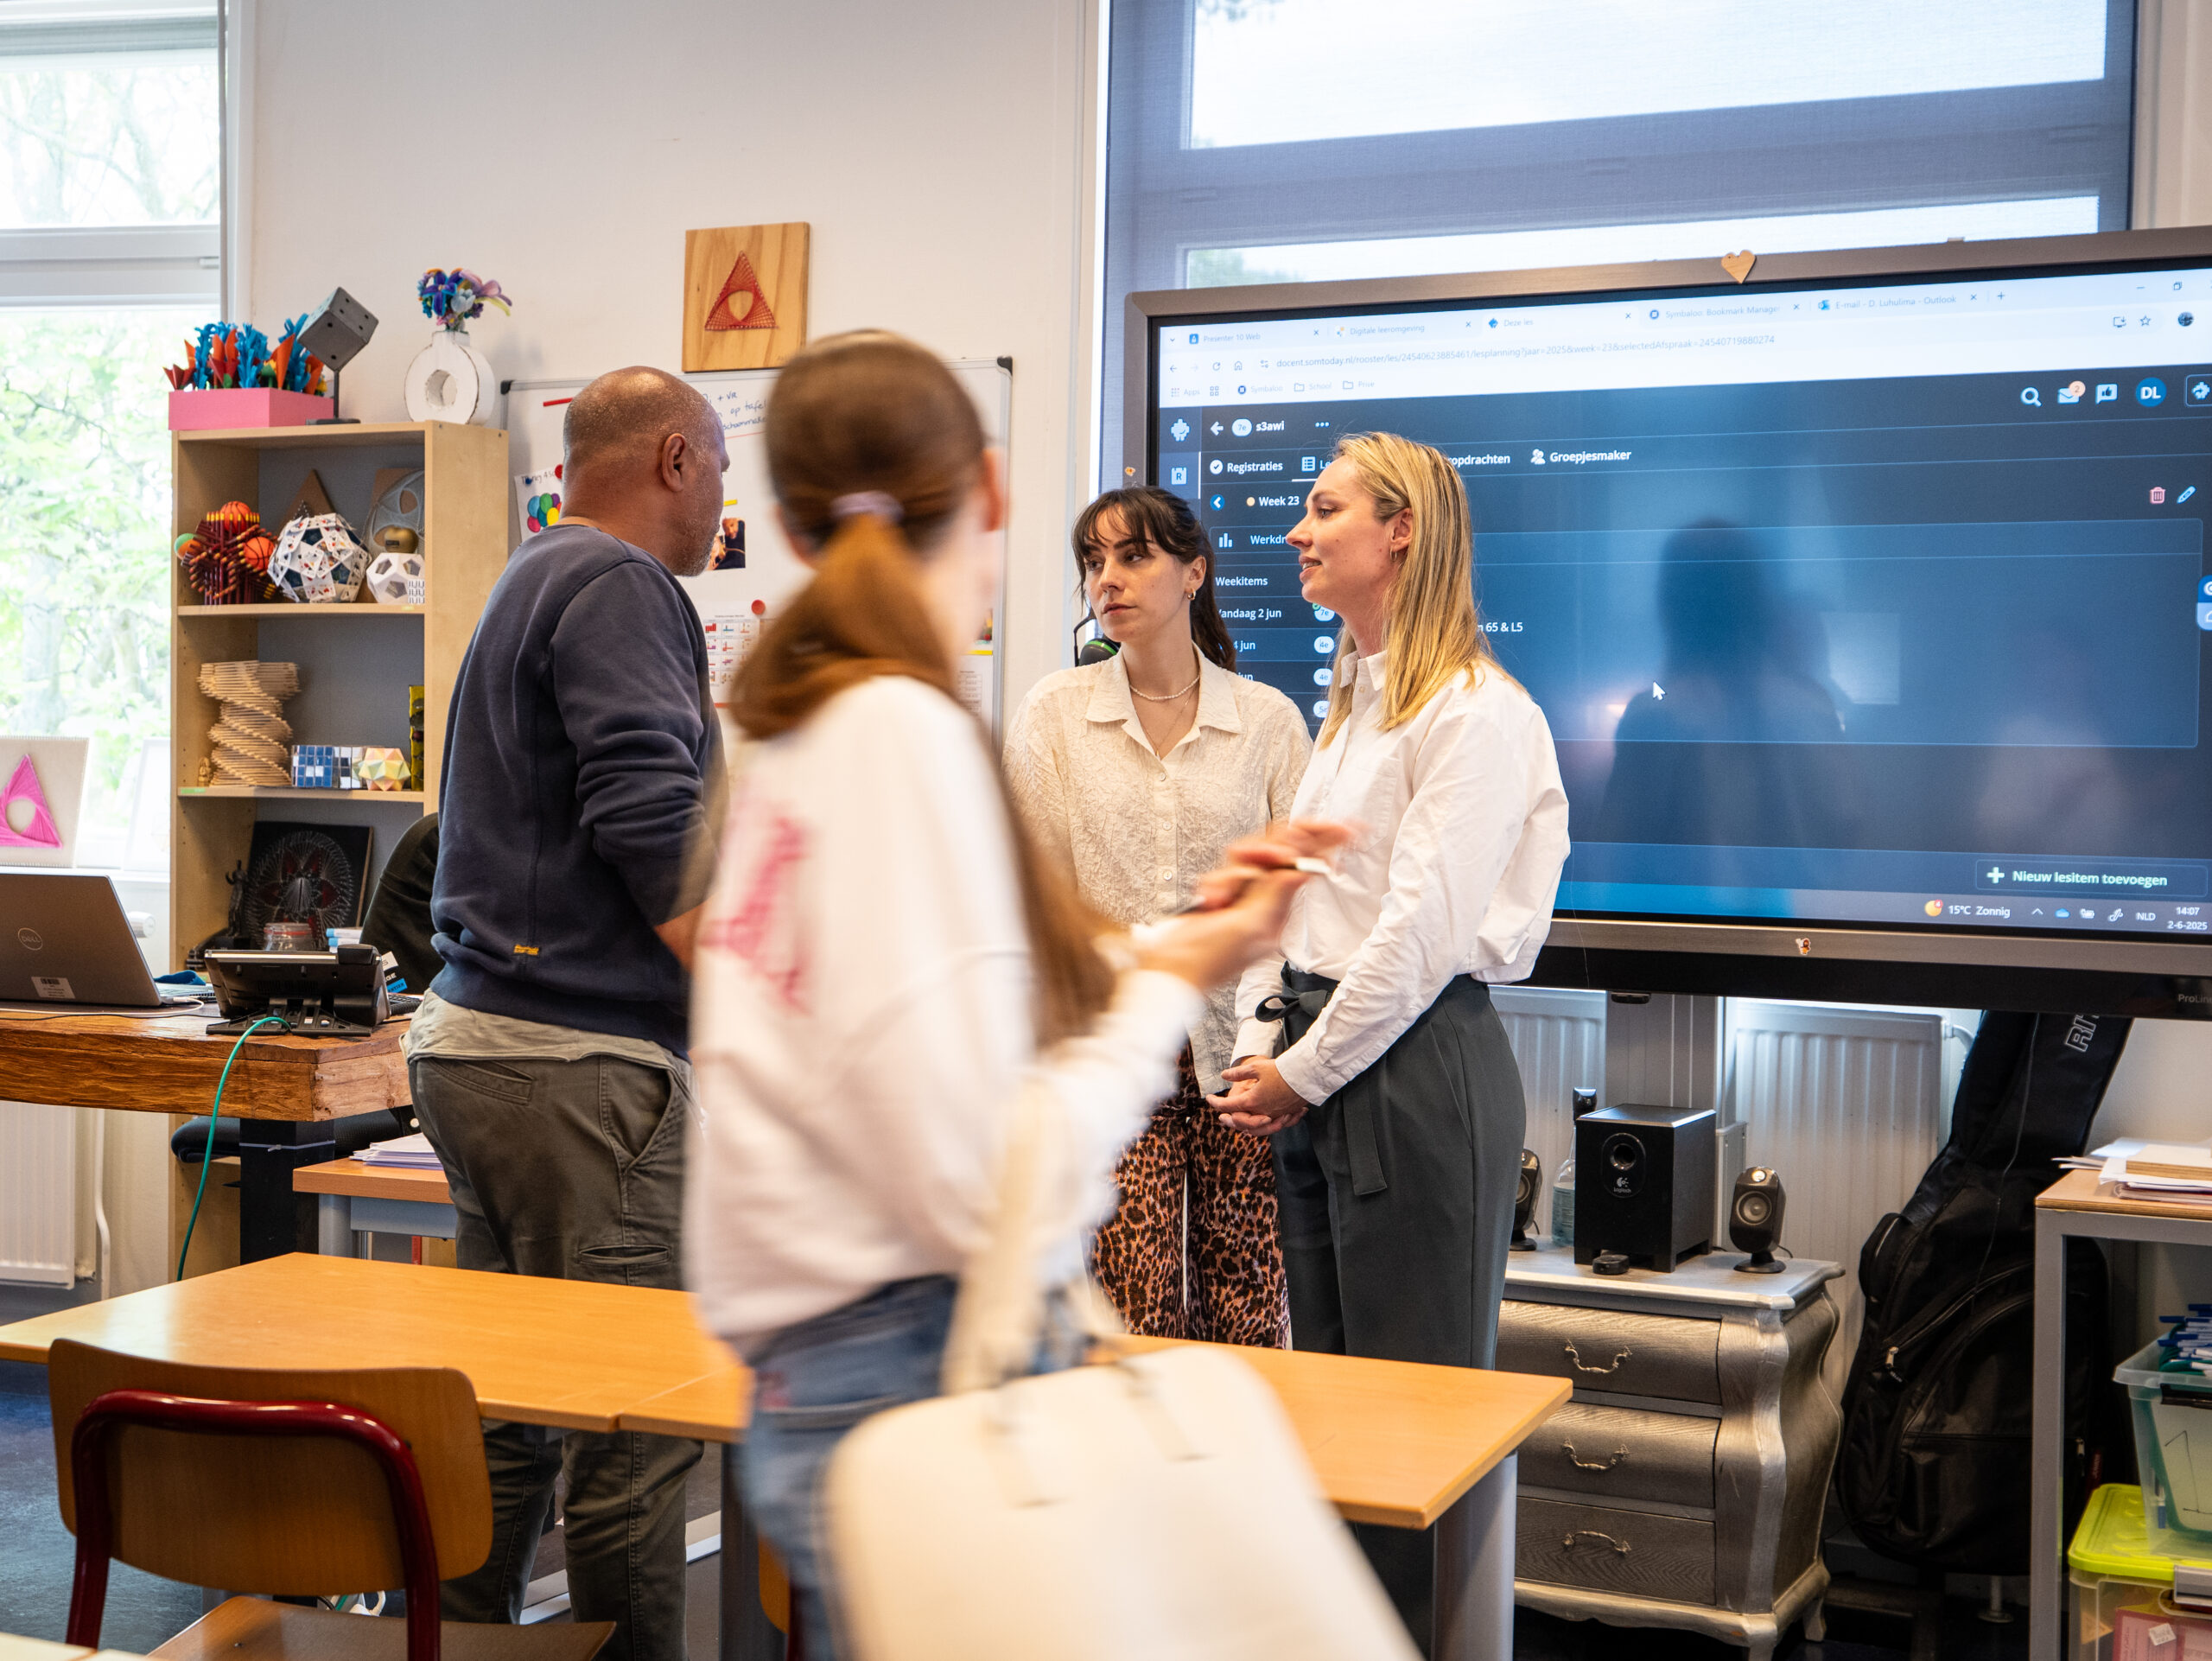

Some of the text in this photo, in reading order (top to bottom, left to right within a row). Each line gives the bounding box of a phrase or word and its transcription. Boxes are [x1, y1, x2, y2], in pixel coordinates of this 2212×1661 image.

[1836, 300, 1860, 309] E-mail
[1879, 297, 1916, 307] Luhulima
[1924, 295, 1956, 305] Outlook
[1707, 306, 1744, 316] Bookmark
[1523, 318, 1534, 327] les
[1350, 323, 1425, 336] Digitale leeromgeving
[1203, 332, 1261, 342] Presenter 10 Web
[1250, 385, 1283, 394] Symbaloo
[1308, 382, 1332, 391] School
[1184, 388, 1200, 397] Apps
[2140, 386, 2161, 400] DL
[730, 407, 741, 417] op
[1255, 420, 1285, 432] s3awi
[1550, 450, 1631, 464] Groepjesmaker
[1227, 462, 1283, 474] Registraties
[1258, 496, 1300, 506] Week 23
[1215, 576, 1268, 587] Weekitems
[1257, 608, 1264, 618] 2
[1265, 608, 1281, 620] jun
[1485, 621, 1498, 633] 65
[1500, 621, 1510, 633] &
[1511, 621, 1523, 633] L5
[1239, 640, 1256, 652] jun
[2012, 870, 2168, 888] Nieuw lesitem toevoegen
[1948, 905, 2011, 919] 15°C Zonnig
[2135, 912, 2157, 921] NLD
[2176, 907, 2200, 916] 14:07
[2167, 920, 2208, 931] 2-6-2025
